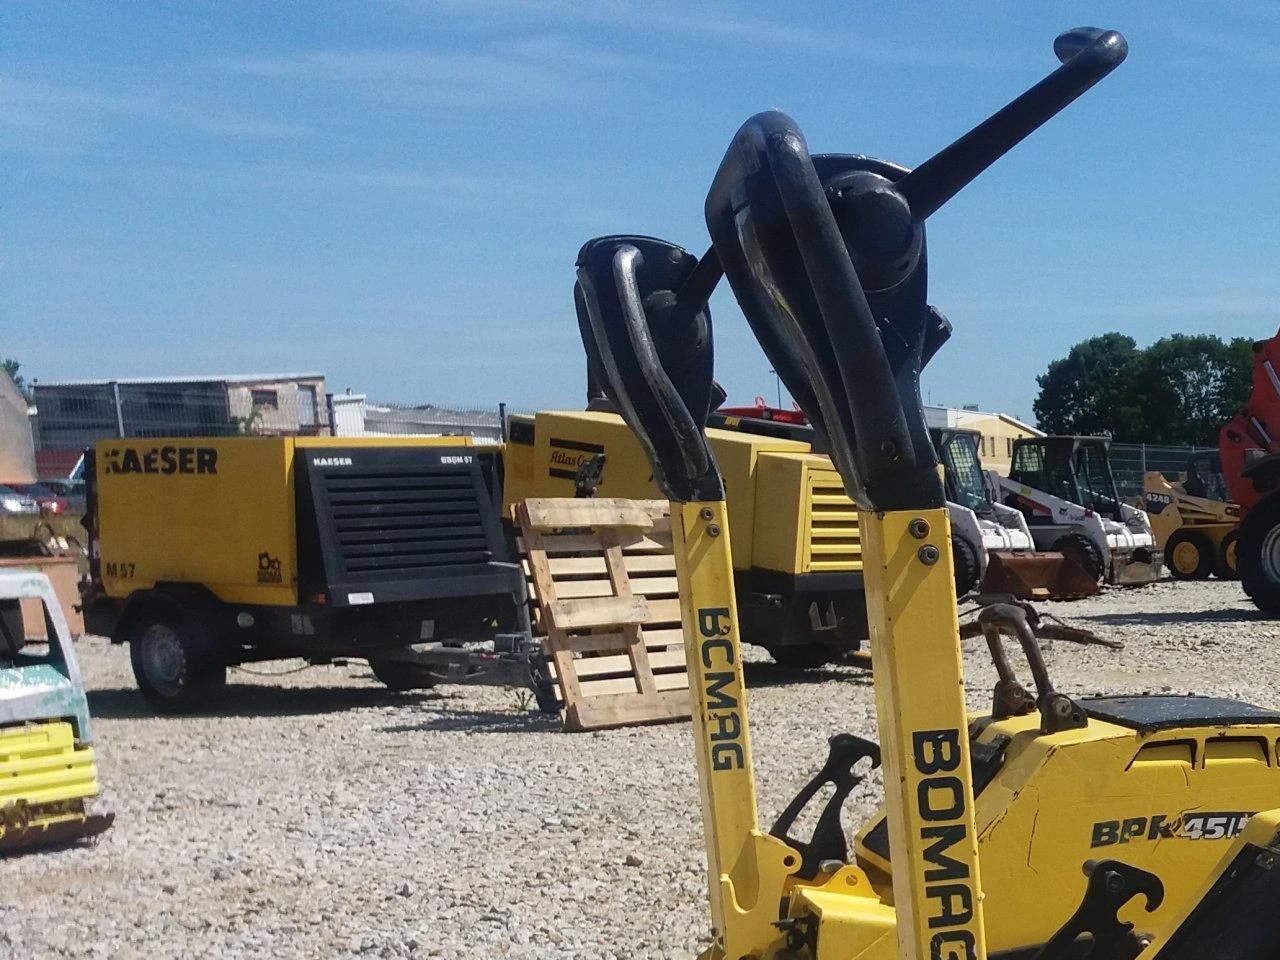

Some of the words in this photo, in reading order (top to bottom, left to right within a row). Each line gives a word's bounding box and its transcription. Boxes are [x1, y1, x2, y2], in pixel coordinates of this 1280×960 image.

[105, 446, 218, 475] KAESER
[313, 457, 353, 466] KAESER
[106, 562, 118, 577] M
[120, 562, 136, 578] 57
